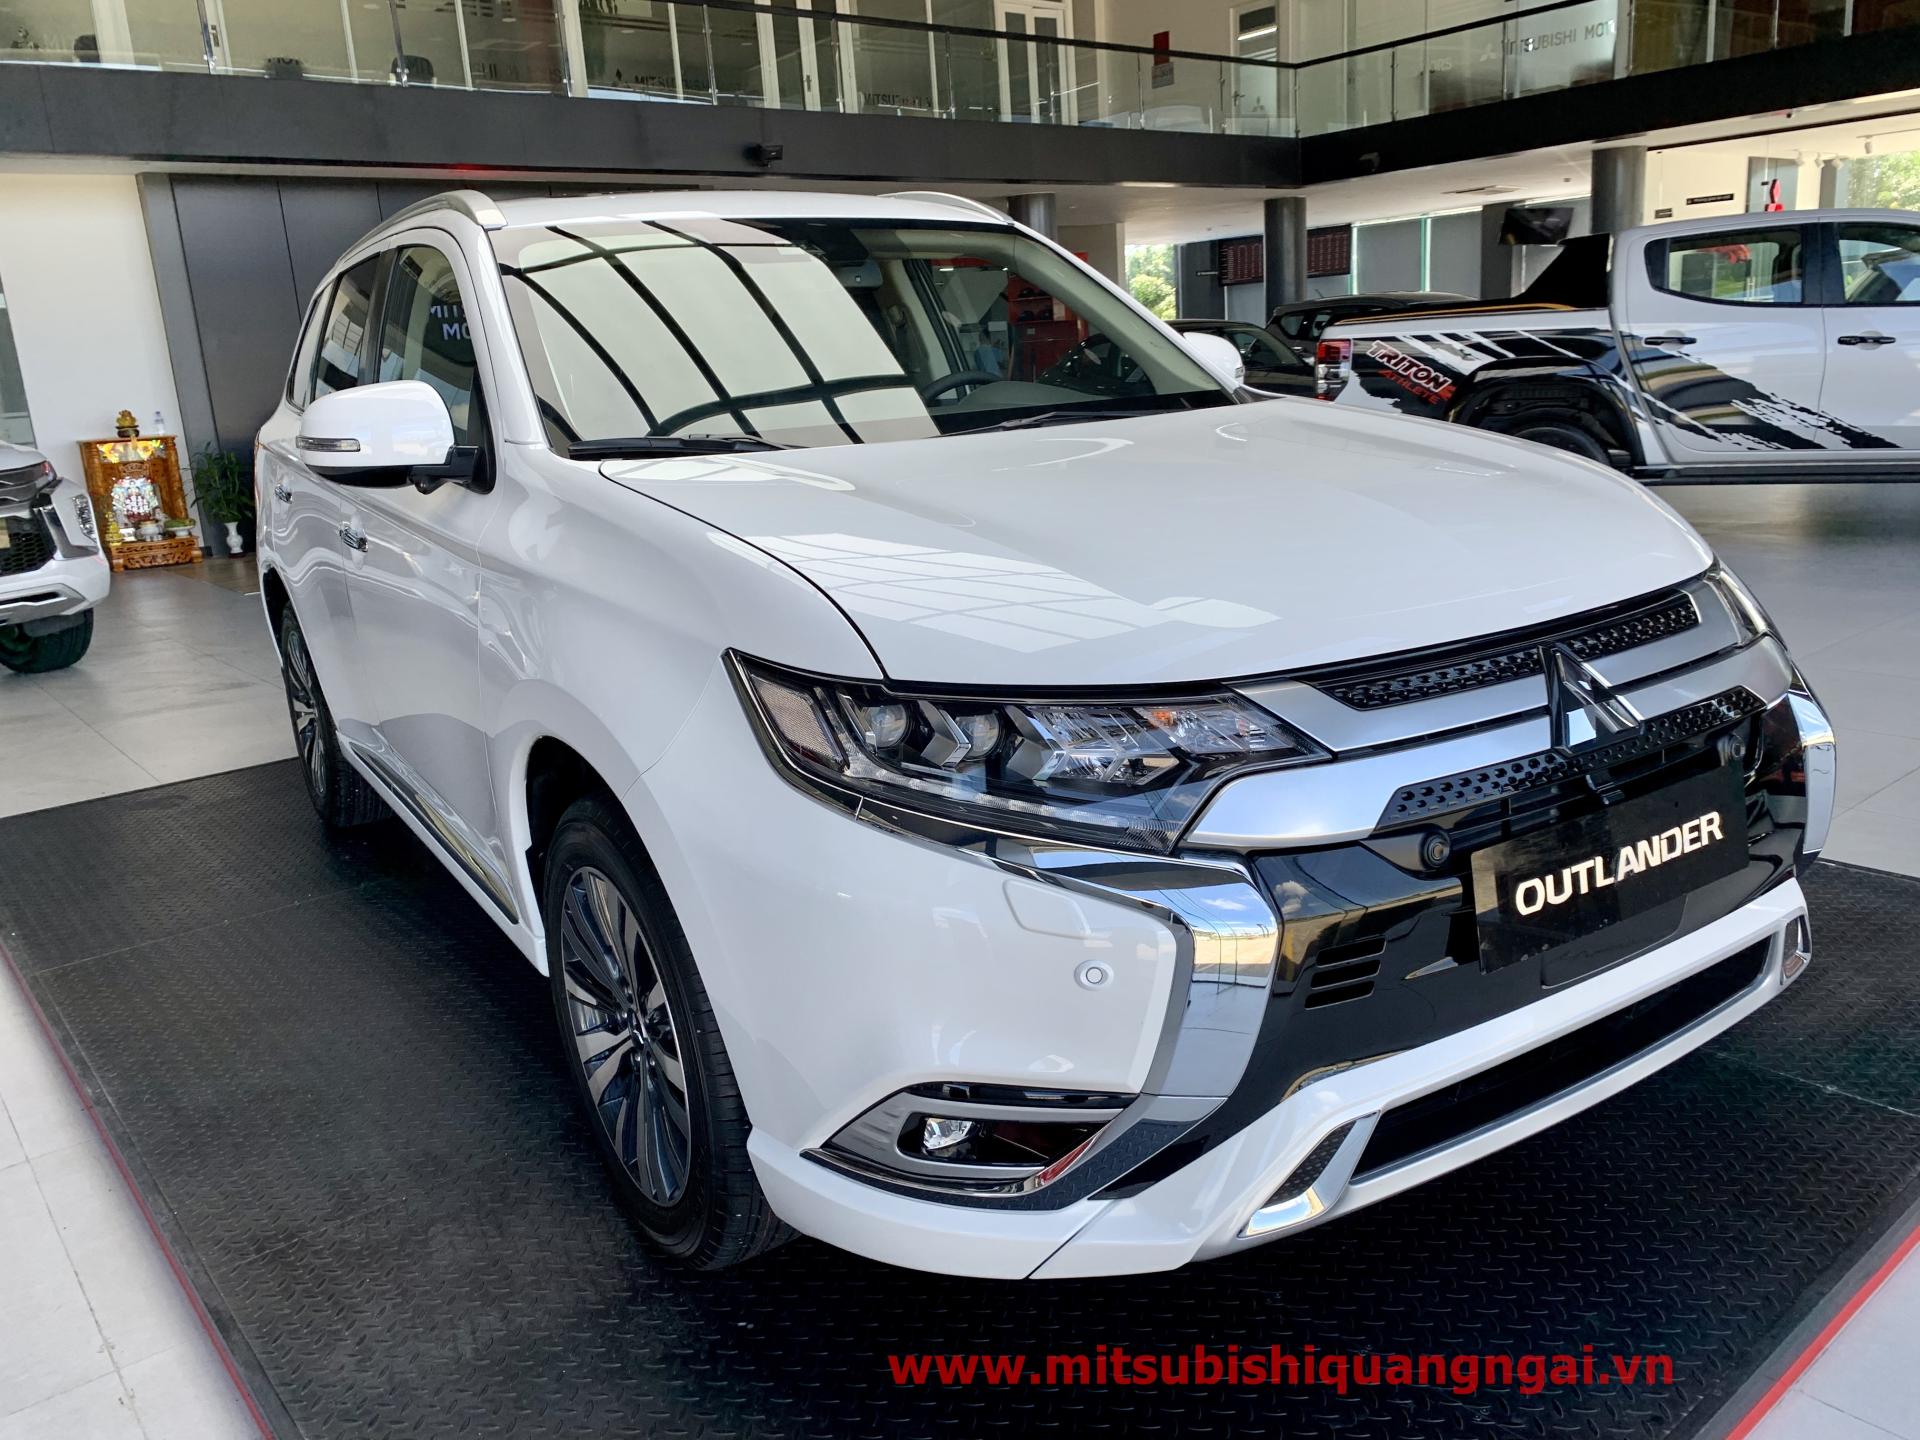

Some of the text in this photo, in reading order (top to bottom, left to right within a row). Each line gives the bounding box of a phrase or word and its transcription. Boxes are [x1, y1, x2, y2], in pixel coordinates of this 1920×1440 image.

[1502, 28, 1577, 56] MTSUBISHI
[1366, 340, 1453, 392] TRITON
[1376, 369, 1439, 405] ATHLETE
[1515, 811, 1724, 916] OUTLANDER
